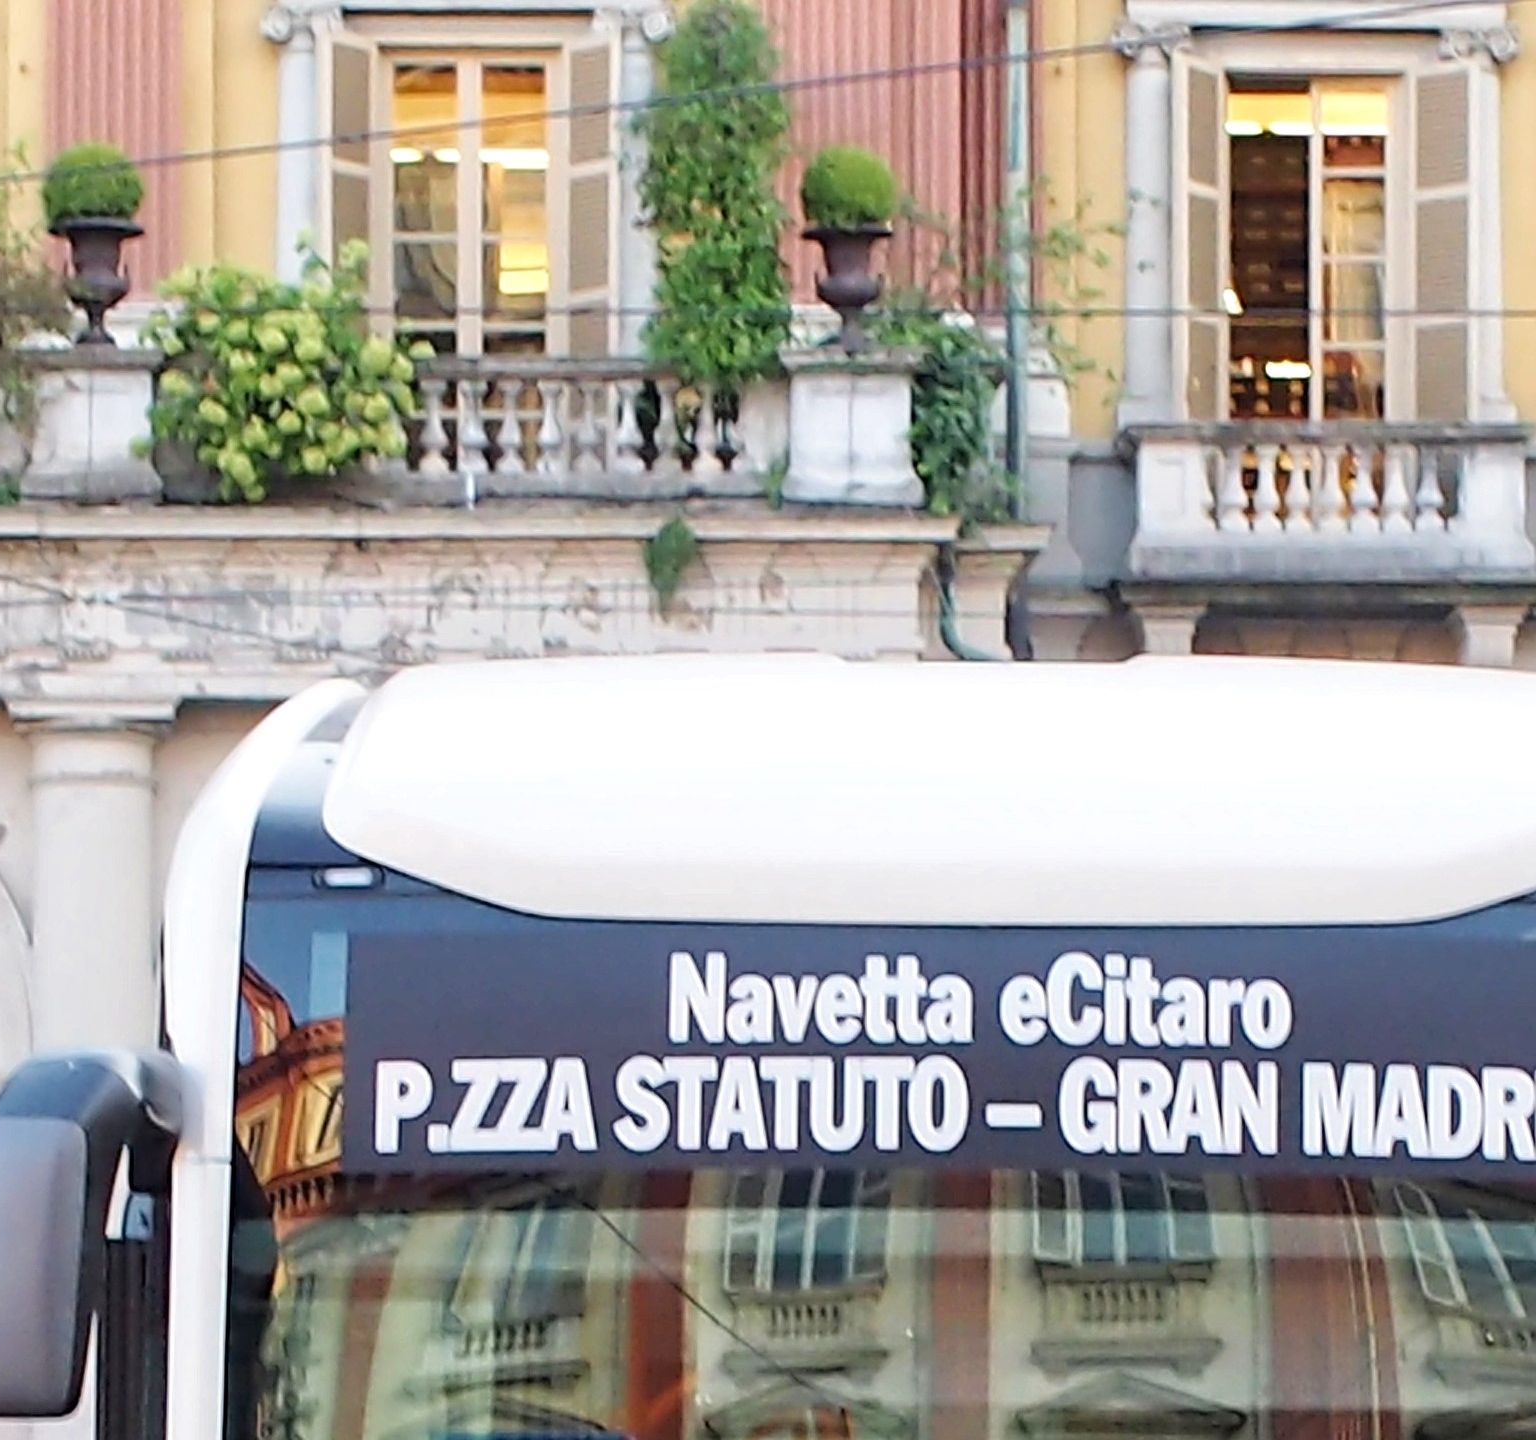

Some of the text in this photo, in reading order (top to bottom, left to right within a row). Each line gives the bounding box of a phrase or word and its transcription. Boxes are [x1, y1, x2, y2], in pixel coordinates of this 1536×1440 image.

[668, 951, 1293, 1049] Navetta eCitaro
[375, 1057, 598, 1153] P.ZZA
[613, 1054, 968, 1152] STATUTO
[1058, 1056, 1279, 1155] GRAN
